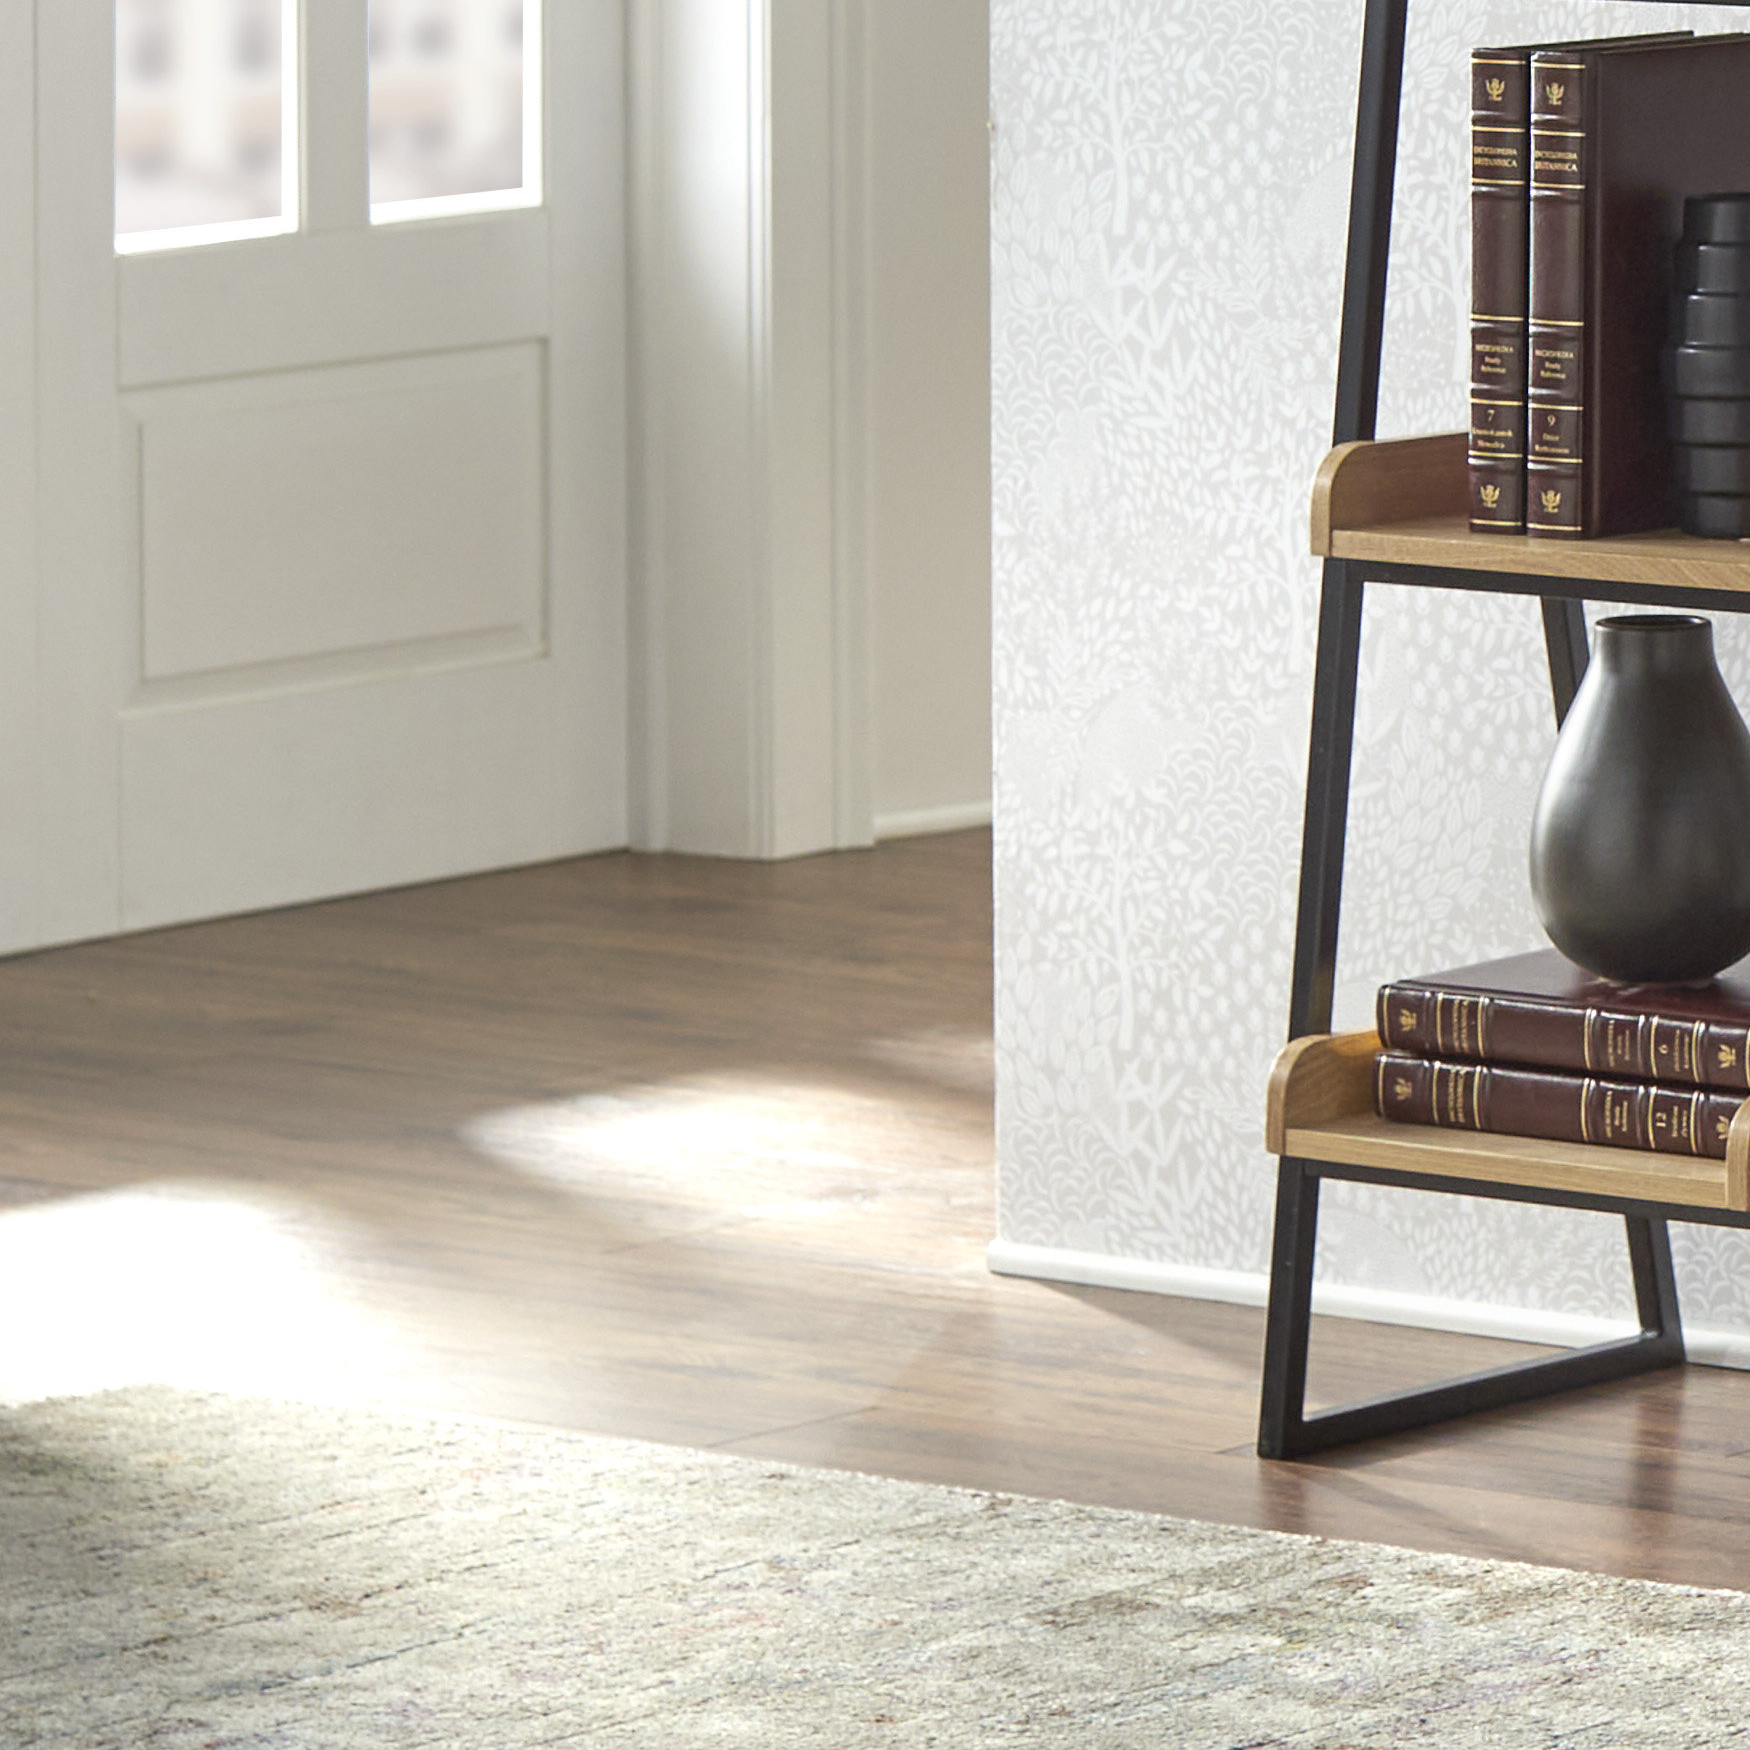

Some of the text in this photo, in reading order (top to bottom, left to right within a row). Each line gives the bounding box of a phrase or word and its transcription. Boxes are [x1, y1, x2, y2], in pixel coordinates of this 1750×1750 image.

[1487, 409, 1495, 422] 7
[1547, 415, 1556, 427] 9
[1659, 1044, 1669, 1054] 6
[1656, 1112, 1667, 1128] 12
